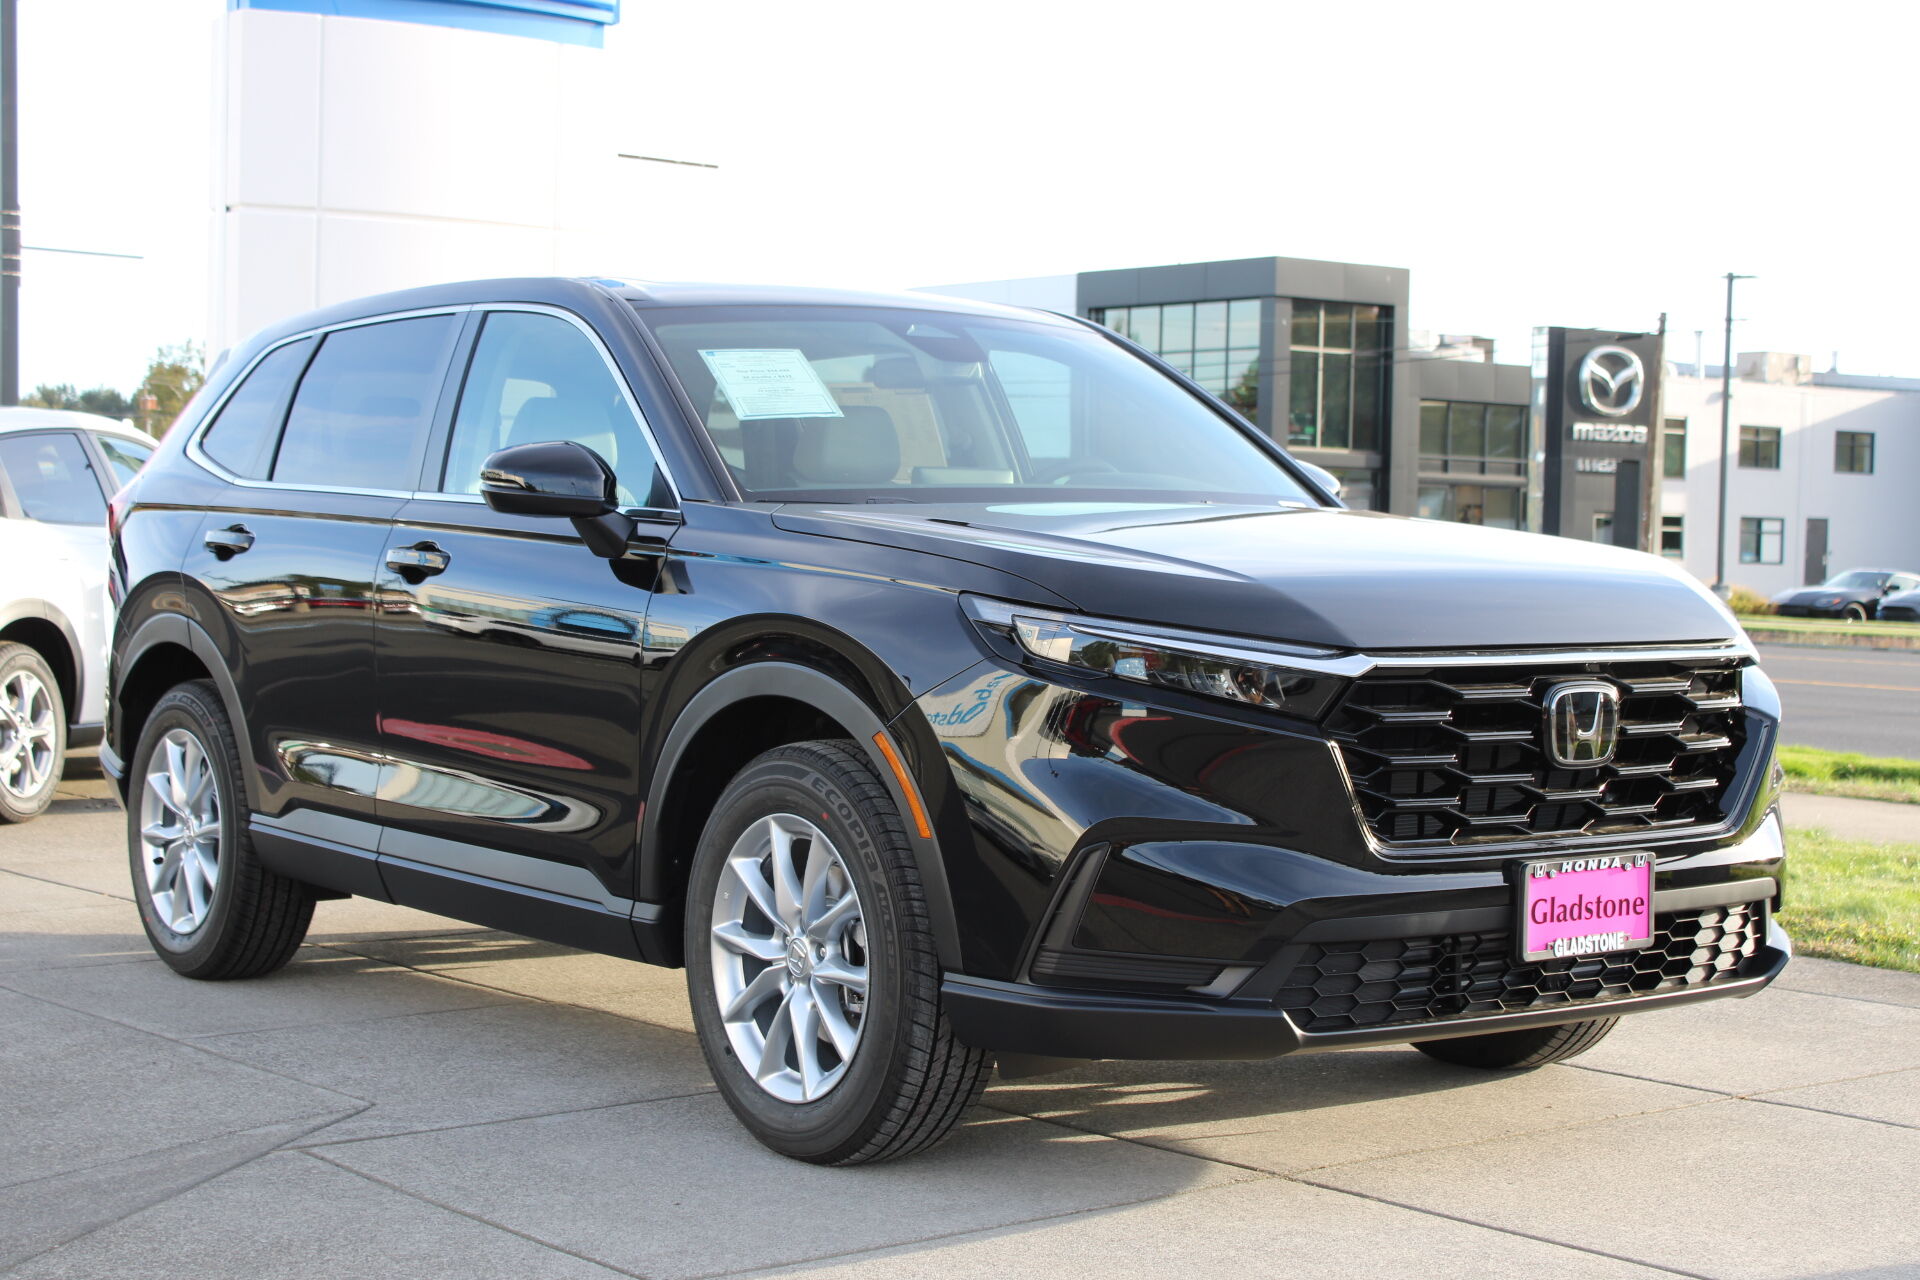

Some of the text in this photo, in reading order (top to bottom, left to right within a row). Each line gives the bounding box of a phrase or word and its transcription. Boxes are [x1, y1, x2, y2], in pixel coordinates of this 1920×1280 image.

[1572, 422, 1648, 444] mazda
[1561, 857, 1622, 873] HONDA
[1530, 894, 1645, 925] Gladstone
[1554, 931, 1625, 958] GLADSTONE
